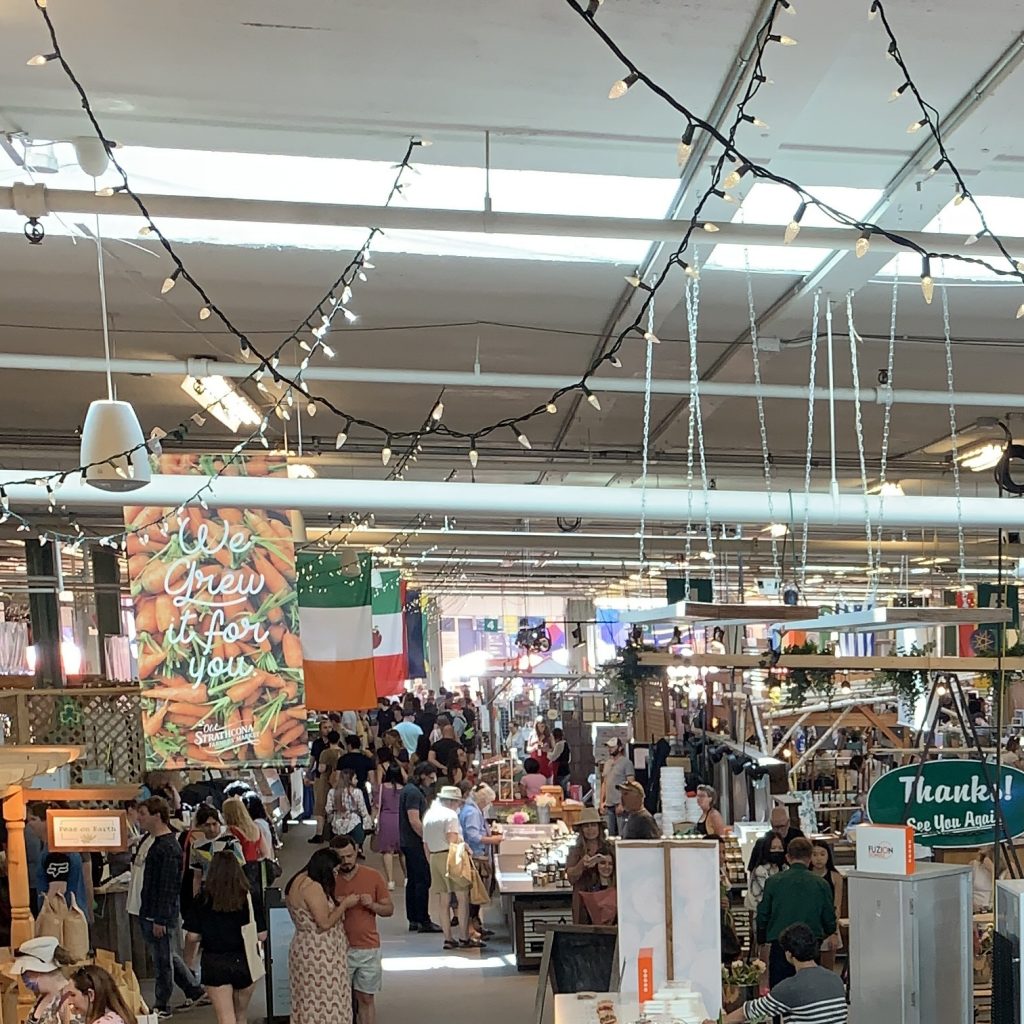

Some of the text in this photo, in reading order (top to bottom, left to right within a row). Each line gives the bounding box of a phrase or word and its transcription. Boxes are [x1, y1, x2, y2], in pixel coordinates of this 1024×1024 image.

[179, 517, 252, 554] We
[164, 558, 265, 607] Grew
[167, 609, 270, 656] it for
[487, 620, 494, 630] 4
[188, 655, 258, 690] you.
[906, 809, 1000, 832] See You Agai
